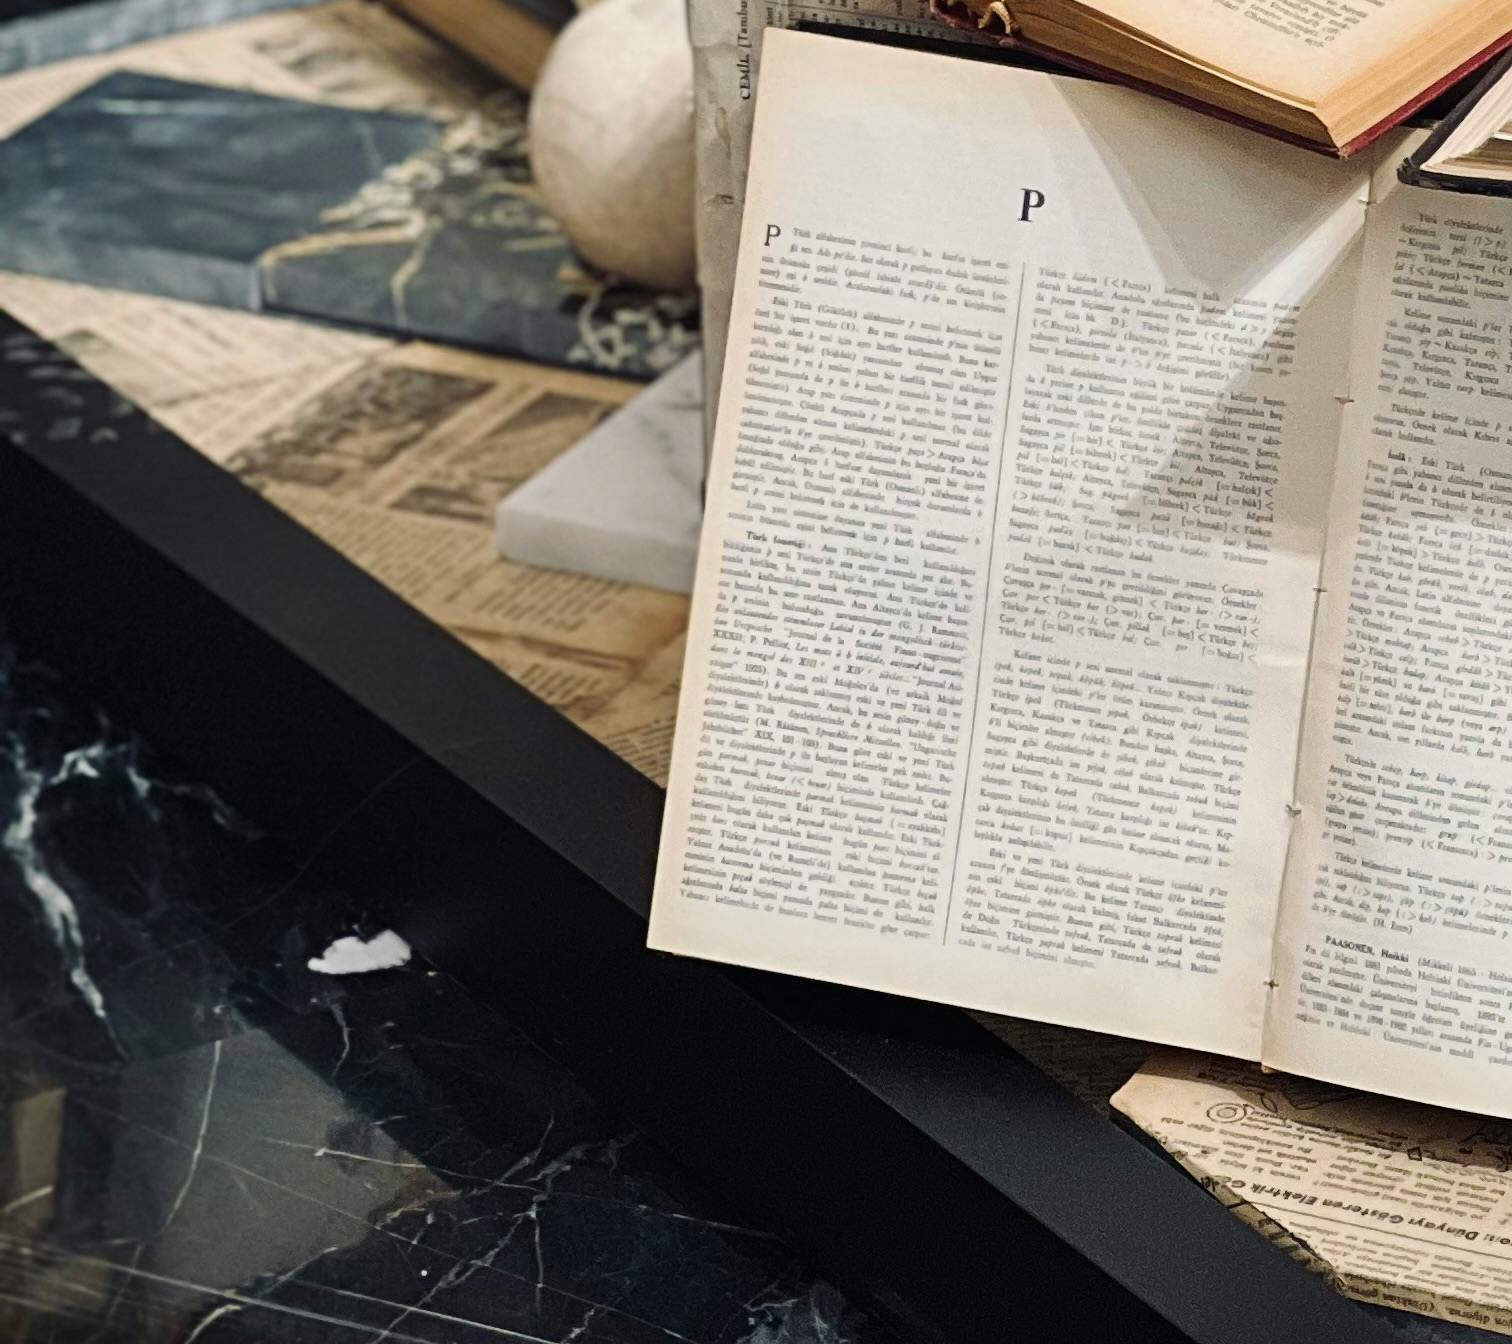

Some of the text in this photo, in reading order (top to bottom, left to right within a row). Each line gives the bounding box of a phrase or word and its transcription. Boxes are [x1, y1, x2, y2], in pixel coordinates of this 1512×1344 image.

[1017, 188, 1046, 223] P
[764, 224, 781, 246] P
[1326, 936, 1374, 955] PAASONEN,
[1251, 1184, 1318, 1205] Elektrik
[1322, 1199, 1404, 1223] Gösteren
